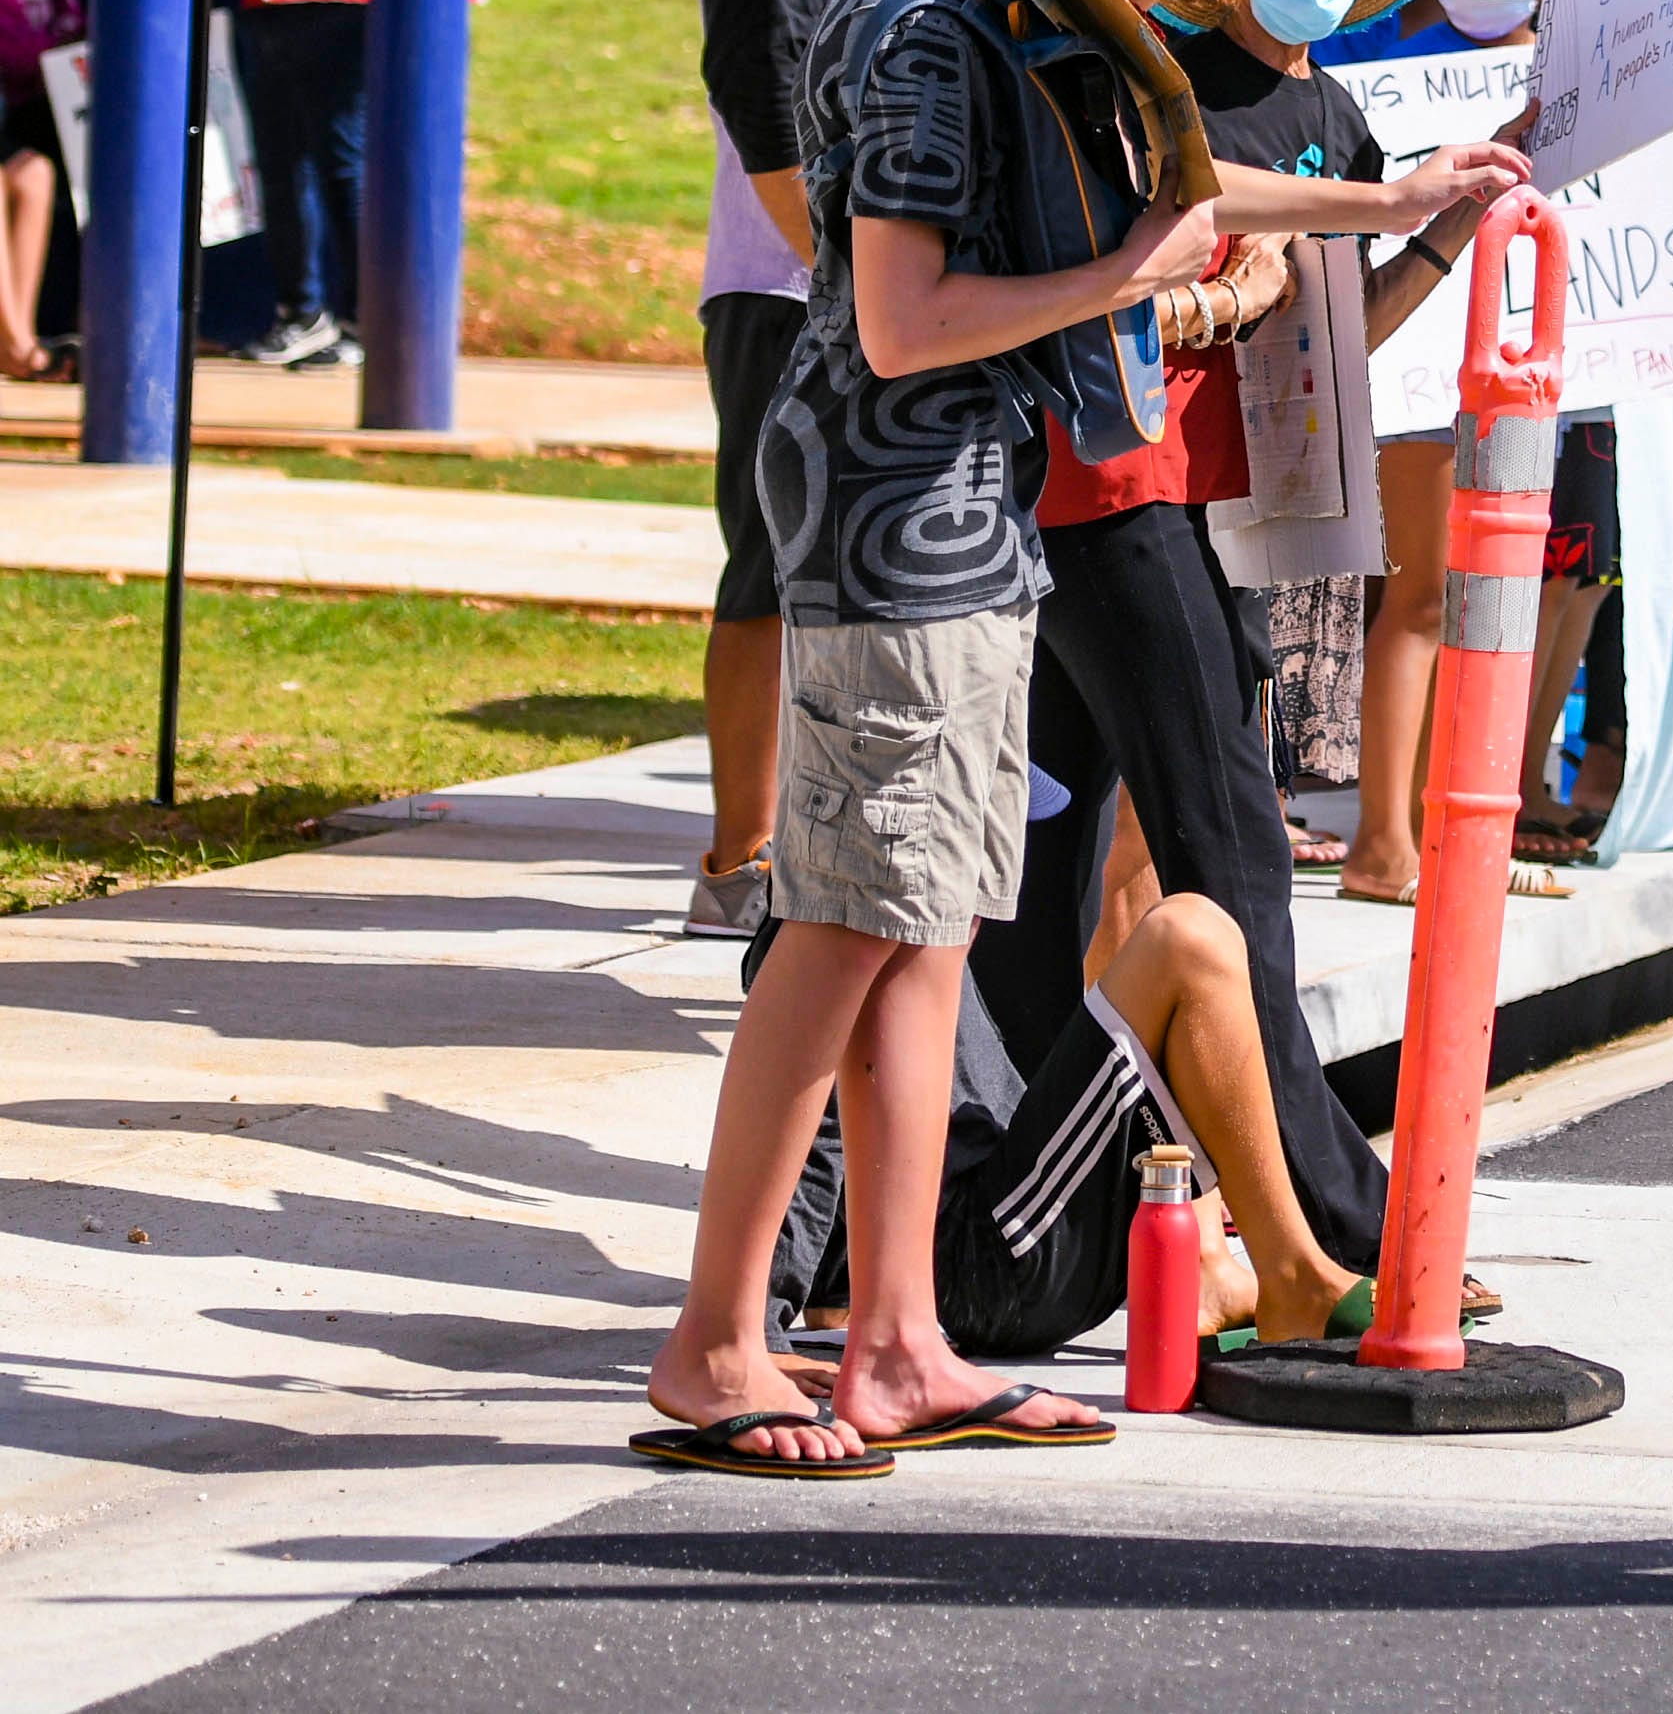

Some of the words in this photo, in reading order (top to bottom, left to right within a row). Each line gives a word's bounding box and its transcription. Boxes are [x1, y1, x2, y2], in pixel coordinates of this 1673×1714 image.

[1591, 24, 1606, 64] A
[1612, 11, 1654, 50] human
[1423, 61, 1530, 103] MILITA
[1597, 60, 1611, 101] A
[1614, 43, 1660, 103] people's
